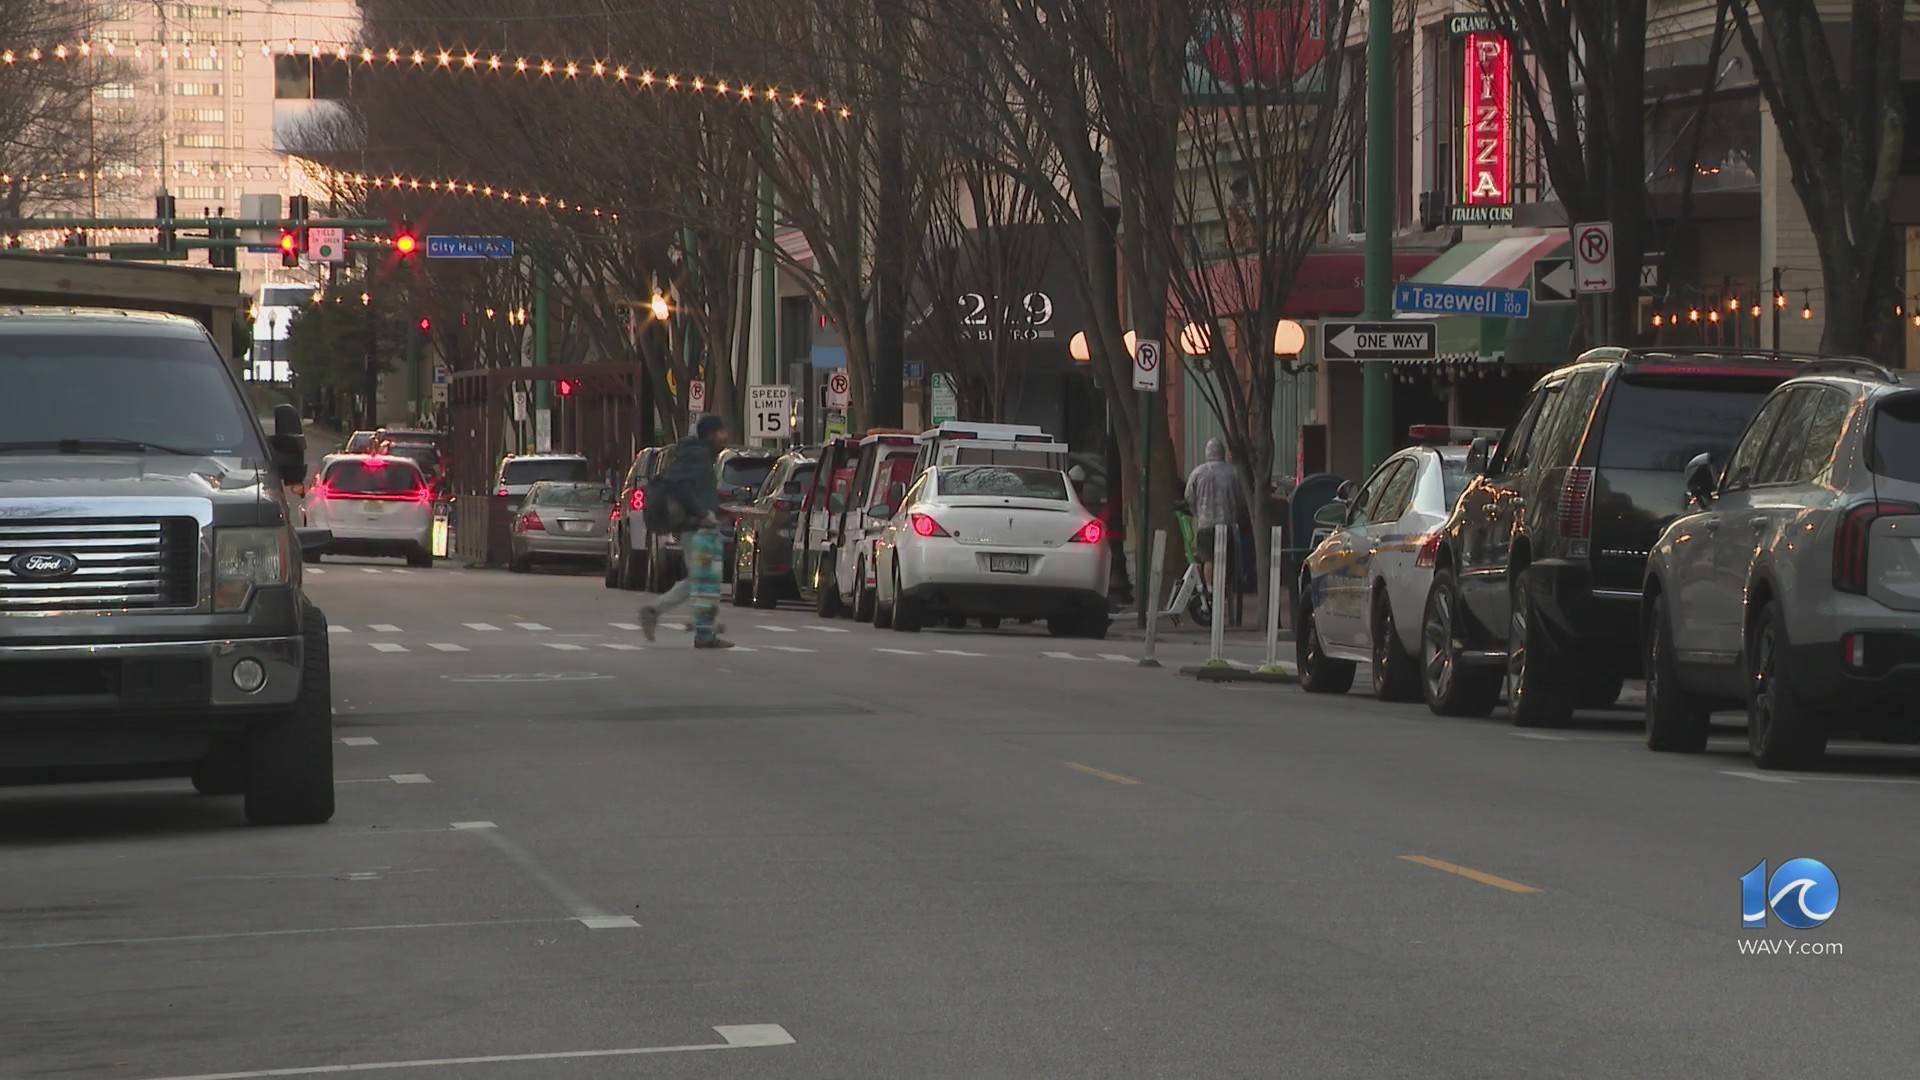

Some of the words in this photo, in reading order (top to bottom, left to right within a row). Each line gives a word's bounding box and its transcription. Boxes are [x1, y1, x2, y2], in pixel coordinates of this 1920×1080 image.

[1472, 40, 1502, 197] PIZZA
[1452, 207, 1488, 221] ITALIAN
[431, 242, 455, 253] City
[1402, 291, 1410, 303] W
[1413, 287, 1497, 313] Tazewell
[1504, 291, 1515, 303] St
[957, 292, 1053, 325] 29
[1504, 302, 1522, 313] 100
[978, 329, 1038, 341] BIRO
[1357, 334, 1387, 348] ONE
[1392, 334, 1424, 348] WAY
[752, 390, 787, 398] SPEED
[754, 400, 783, 409] LIMIT
[757, 412, 781, 431] 15
[26, 555, 61, 570] Ford
